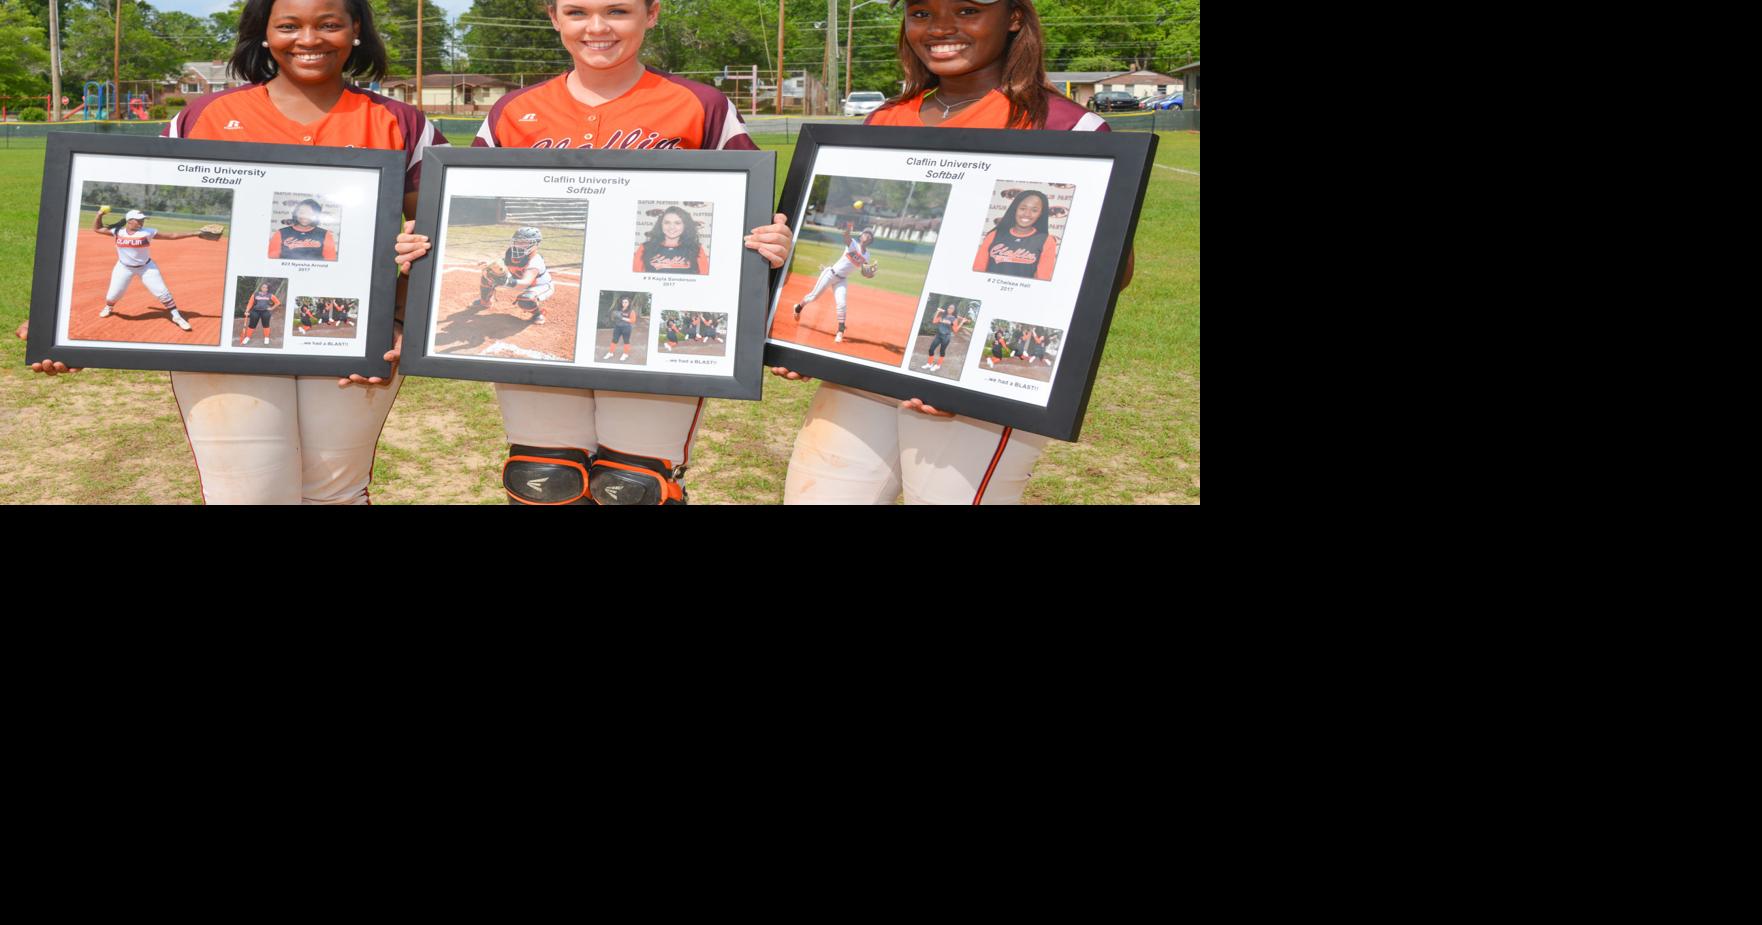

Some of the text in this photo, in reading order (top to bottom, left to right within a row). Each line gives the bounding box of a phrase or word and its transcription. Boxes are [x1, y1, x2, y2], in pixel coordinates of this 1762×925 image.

[906, 157, 991, 172] Claflin University
[177, 164, 266, 178] Claflin University
[925, 169, 966, 180] Softball
[201, 175, 242, 185] Softball
[543, 175, 631, 187] Claflin University
[566, 186, 606, 195] Softball
